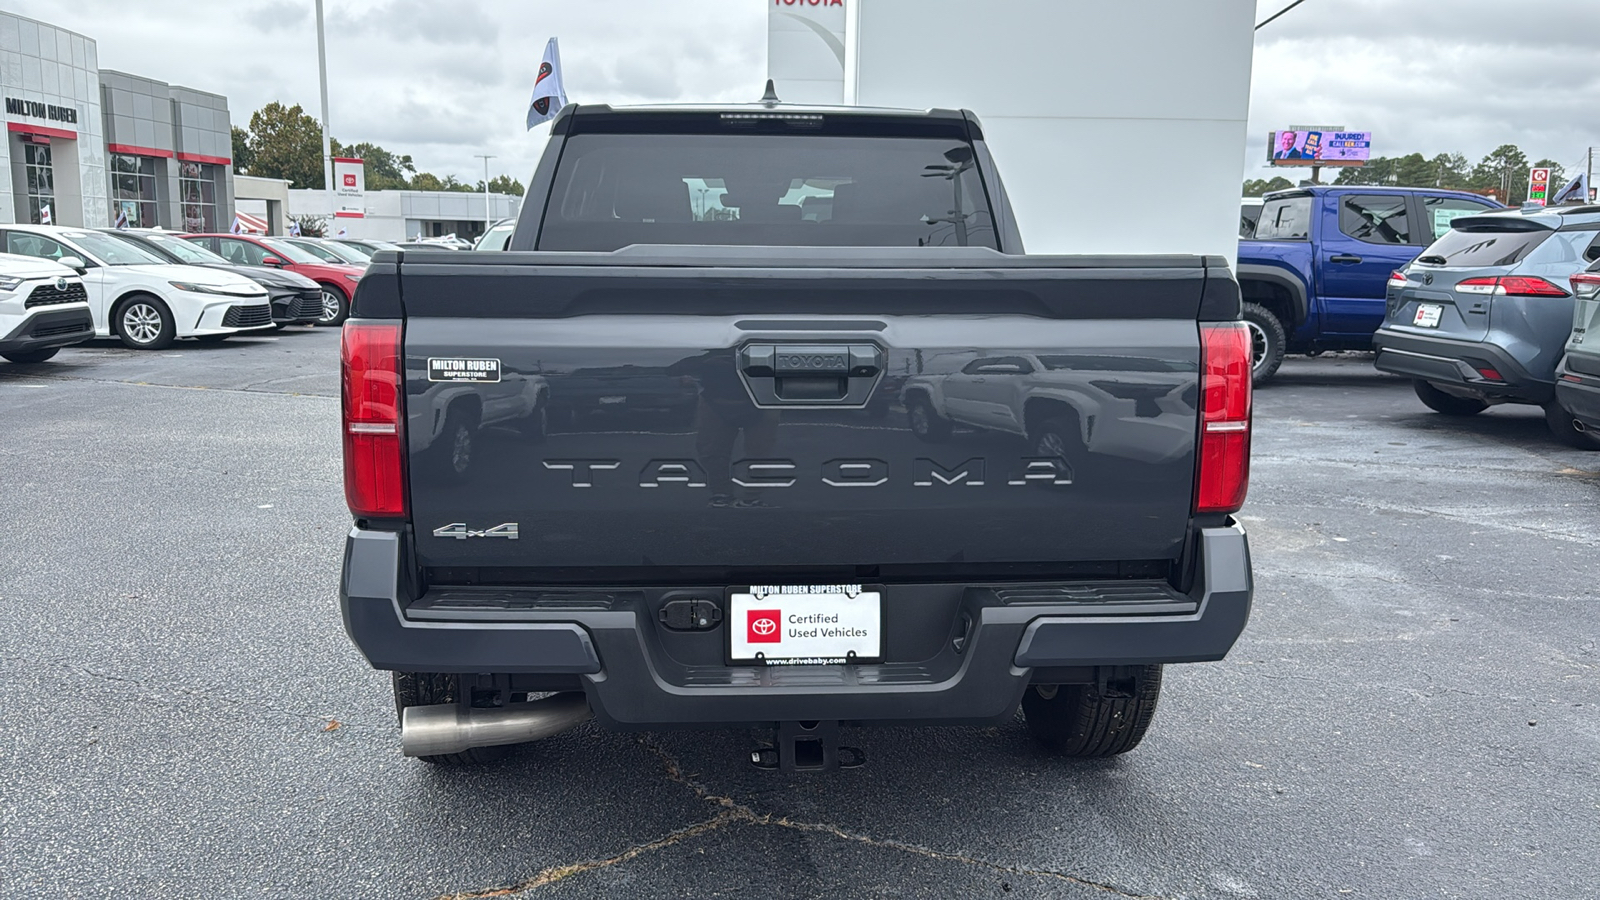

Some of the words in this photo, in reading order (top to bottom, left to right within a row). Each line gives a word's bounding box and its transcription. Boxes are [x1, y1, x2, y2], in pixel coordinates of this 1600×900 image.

[5, 97, 46, 119] MILTON
[47, 104, 77, 124] RUBEN
[432, 360, 465, 370] MILTON
[467, 360, 497, 371] RUBEN
[779, 355, 845, 368] TOYOTA
[542, 457, 1074, 487] TACOMA
[750, 585, 780, 594] MILTON
[781, 585, 808, 594] RUBEN
[810, 584, 862, 594] SUPERSTORE
[788, 613, 839, 624] Certified
[788, 628, 818, 638] Used
[820, 627, 868, 638] Vehicles
[766, 658, 846, 666] www.drivebaby.com
